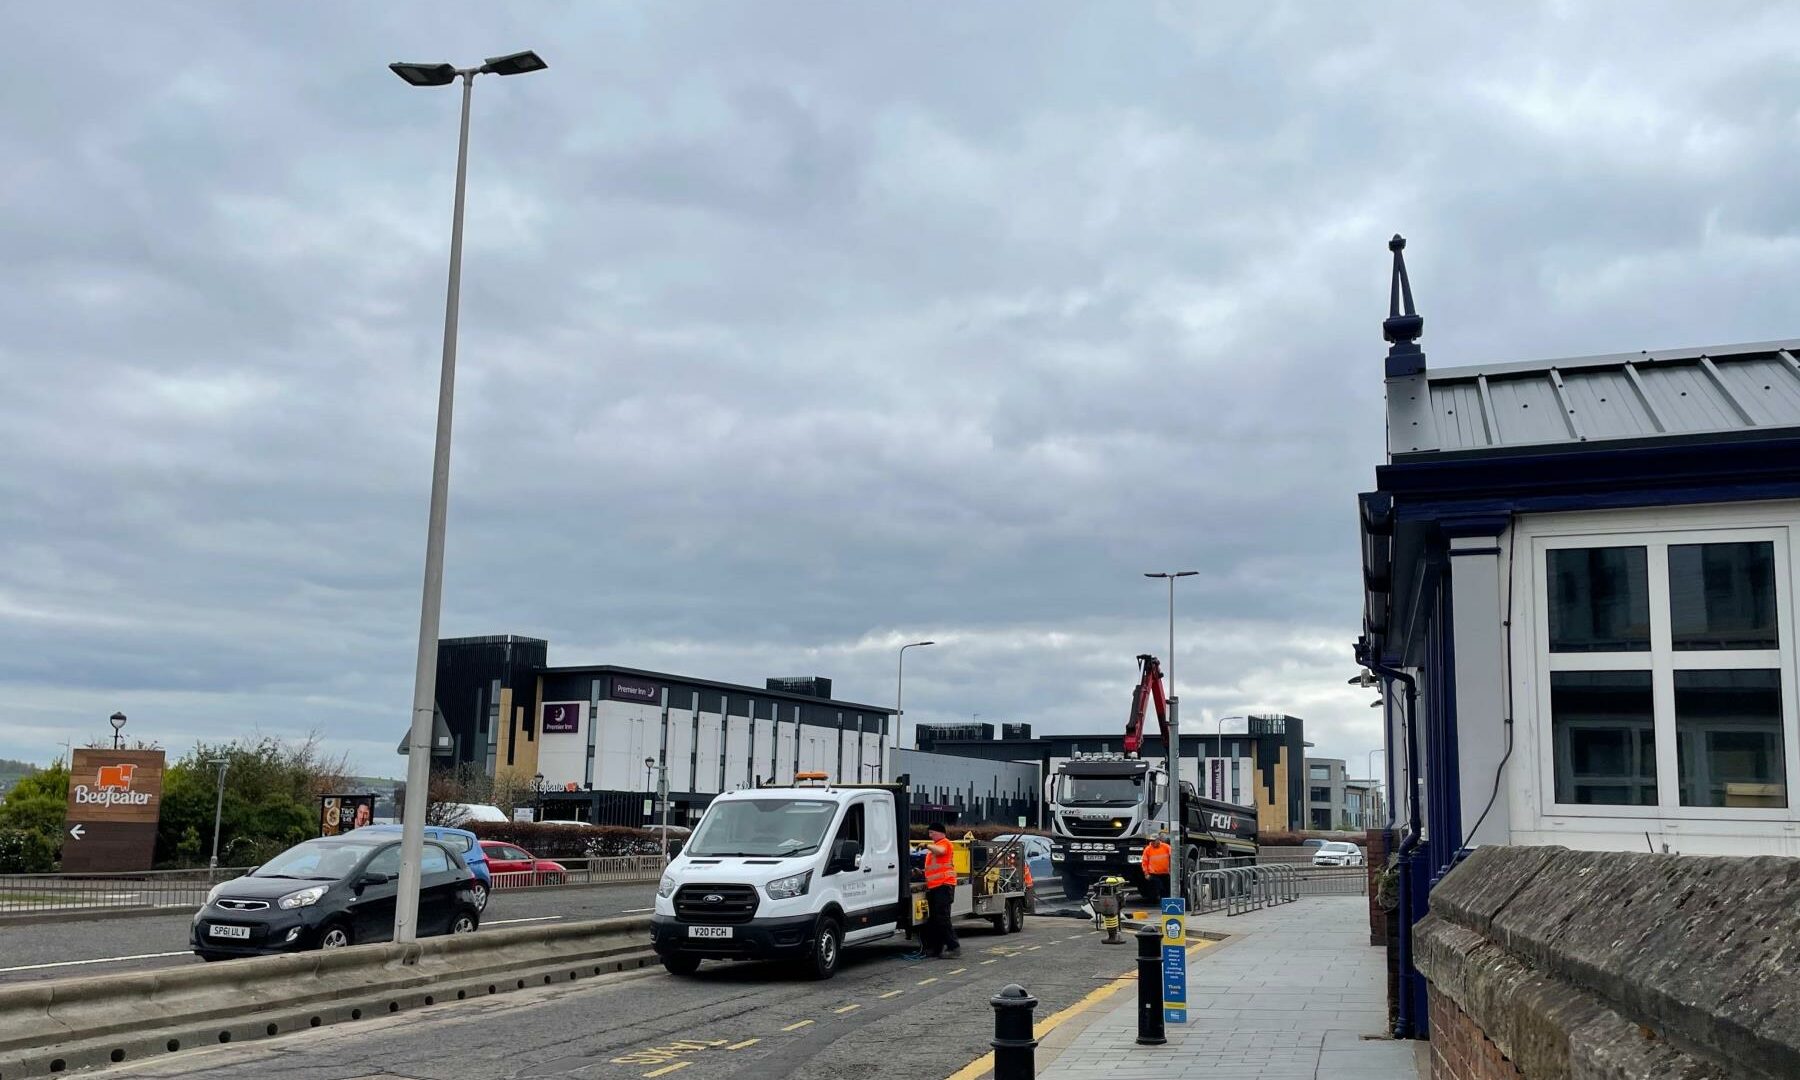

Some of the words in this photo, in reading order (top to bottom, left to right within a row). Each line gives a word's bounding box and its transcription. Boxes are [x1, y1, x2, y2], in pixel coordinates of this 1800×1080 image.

[617, 684, 638, 695] Premier
[74, 784, 153, 808] Beefeater
[1210, 812, 1231, 830] FCH
[214, 926, 231, 935] SP61
[694, 927, 709, 936] V20
[710, 927, 727, 937] FCH
